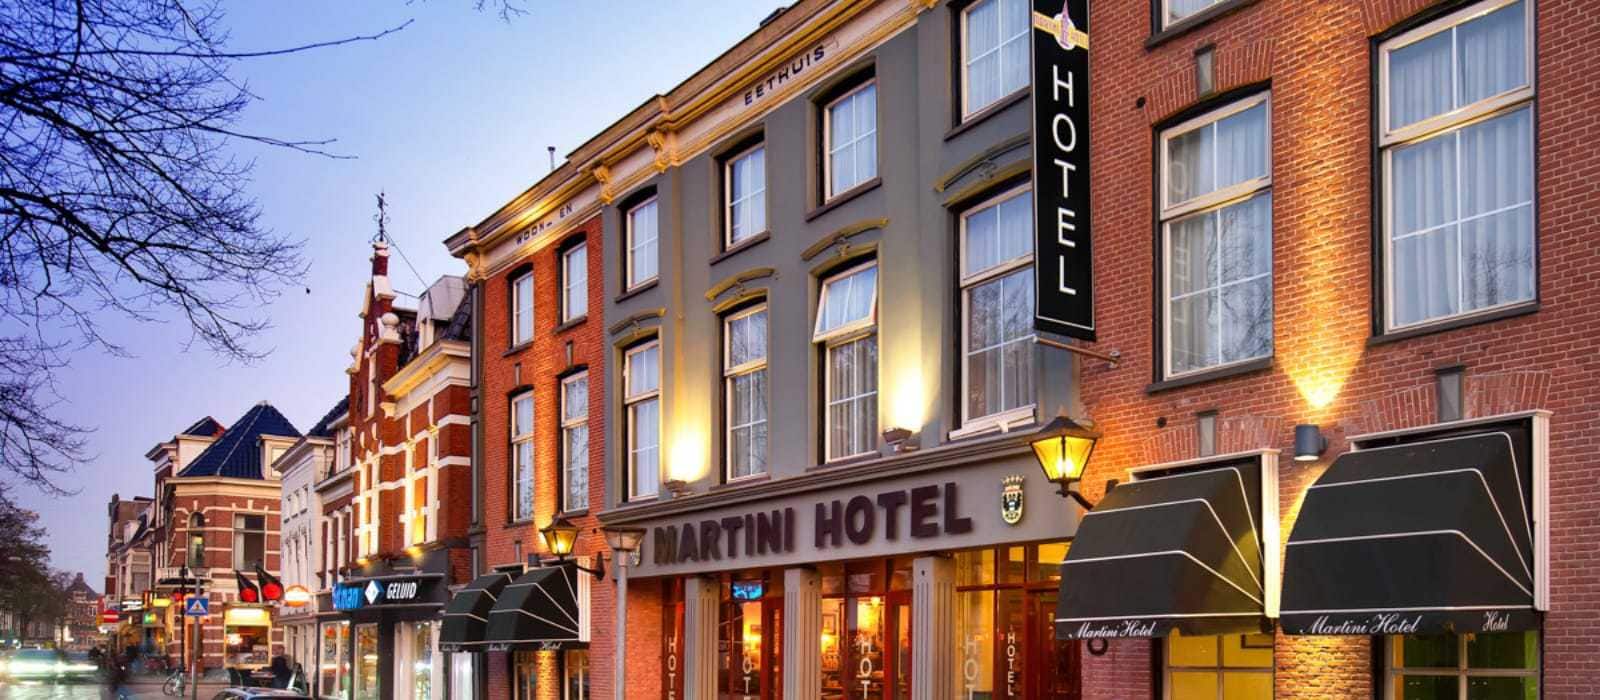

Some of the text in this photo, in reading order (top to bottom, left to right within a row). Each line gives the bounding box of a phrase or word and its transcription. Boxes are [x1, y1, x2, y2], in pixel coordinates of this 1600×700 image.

[744, 45, 825, 106] EETHUIS
[1052, 64, 1076, 295] HOTEL
[653, 482, 972, 565] MARTINI HOTEL
[386, 582, 417, 599] GELUID
[1068, 619, 1157, 639] Martini Hotel
[1297, 611, 1509, 635] Martini Hotel Hotel
[1007, 632, 1016, 697] HOTEL
